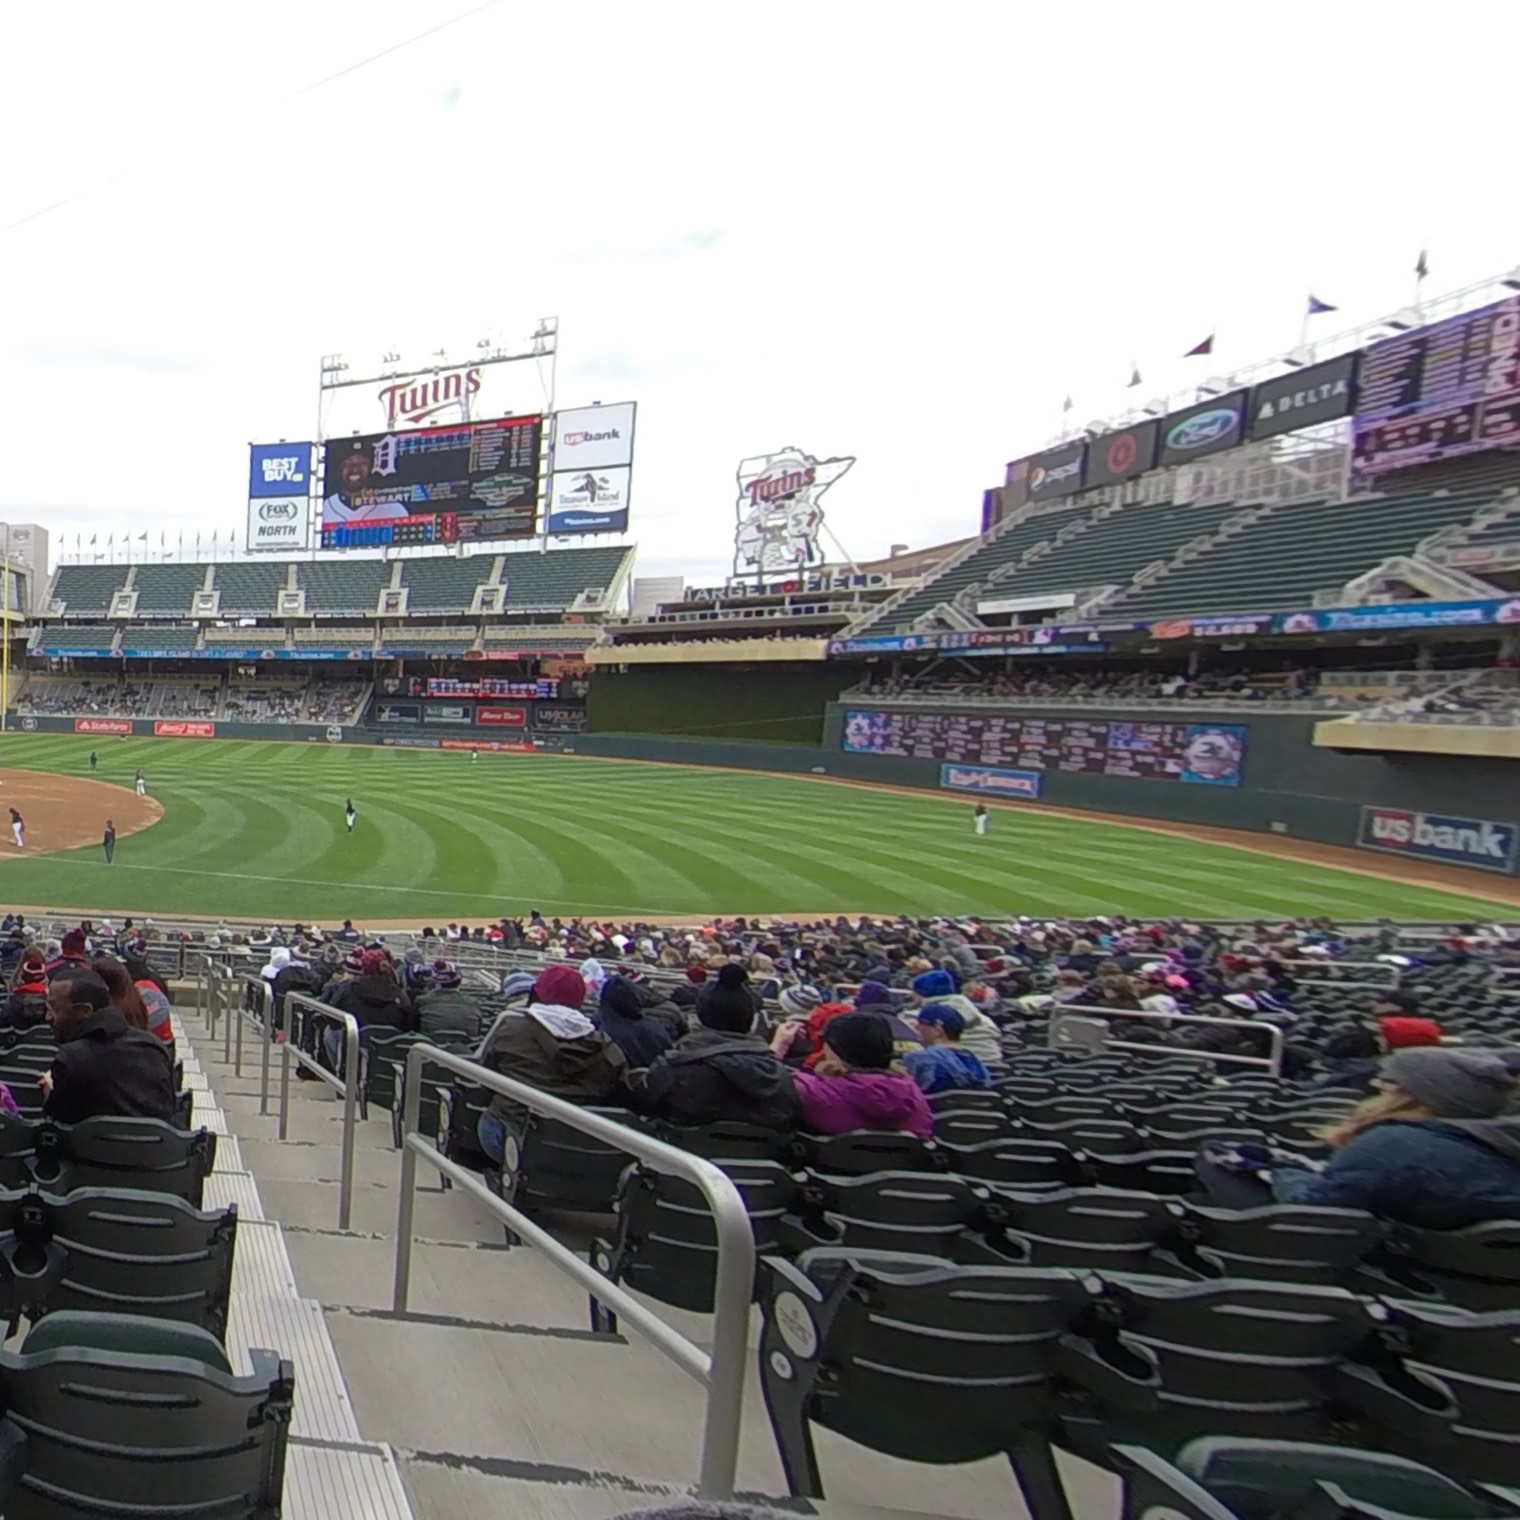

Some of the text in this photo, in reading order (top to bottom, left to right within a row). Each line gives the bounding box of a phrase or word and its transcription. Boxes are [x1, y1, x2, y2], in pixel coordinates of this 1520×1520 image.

[378, 367, 481, 420] Twins
[1279, 380, 1346, 412] DELTA
[262, 457, 299, 471] BEST
[264, 470, 295, 482] BUY
[745, 467, 815, 507] Twins
[266, 503, 290, 514] FOX
[258, 525, 297, 536] NORTH
